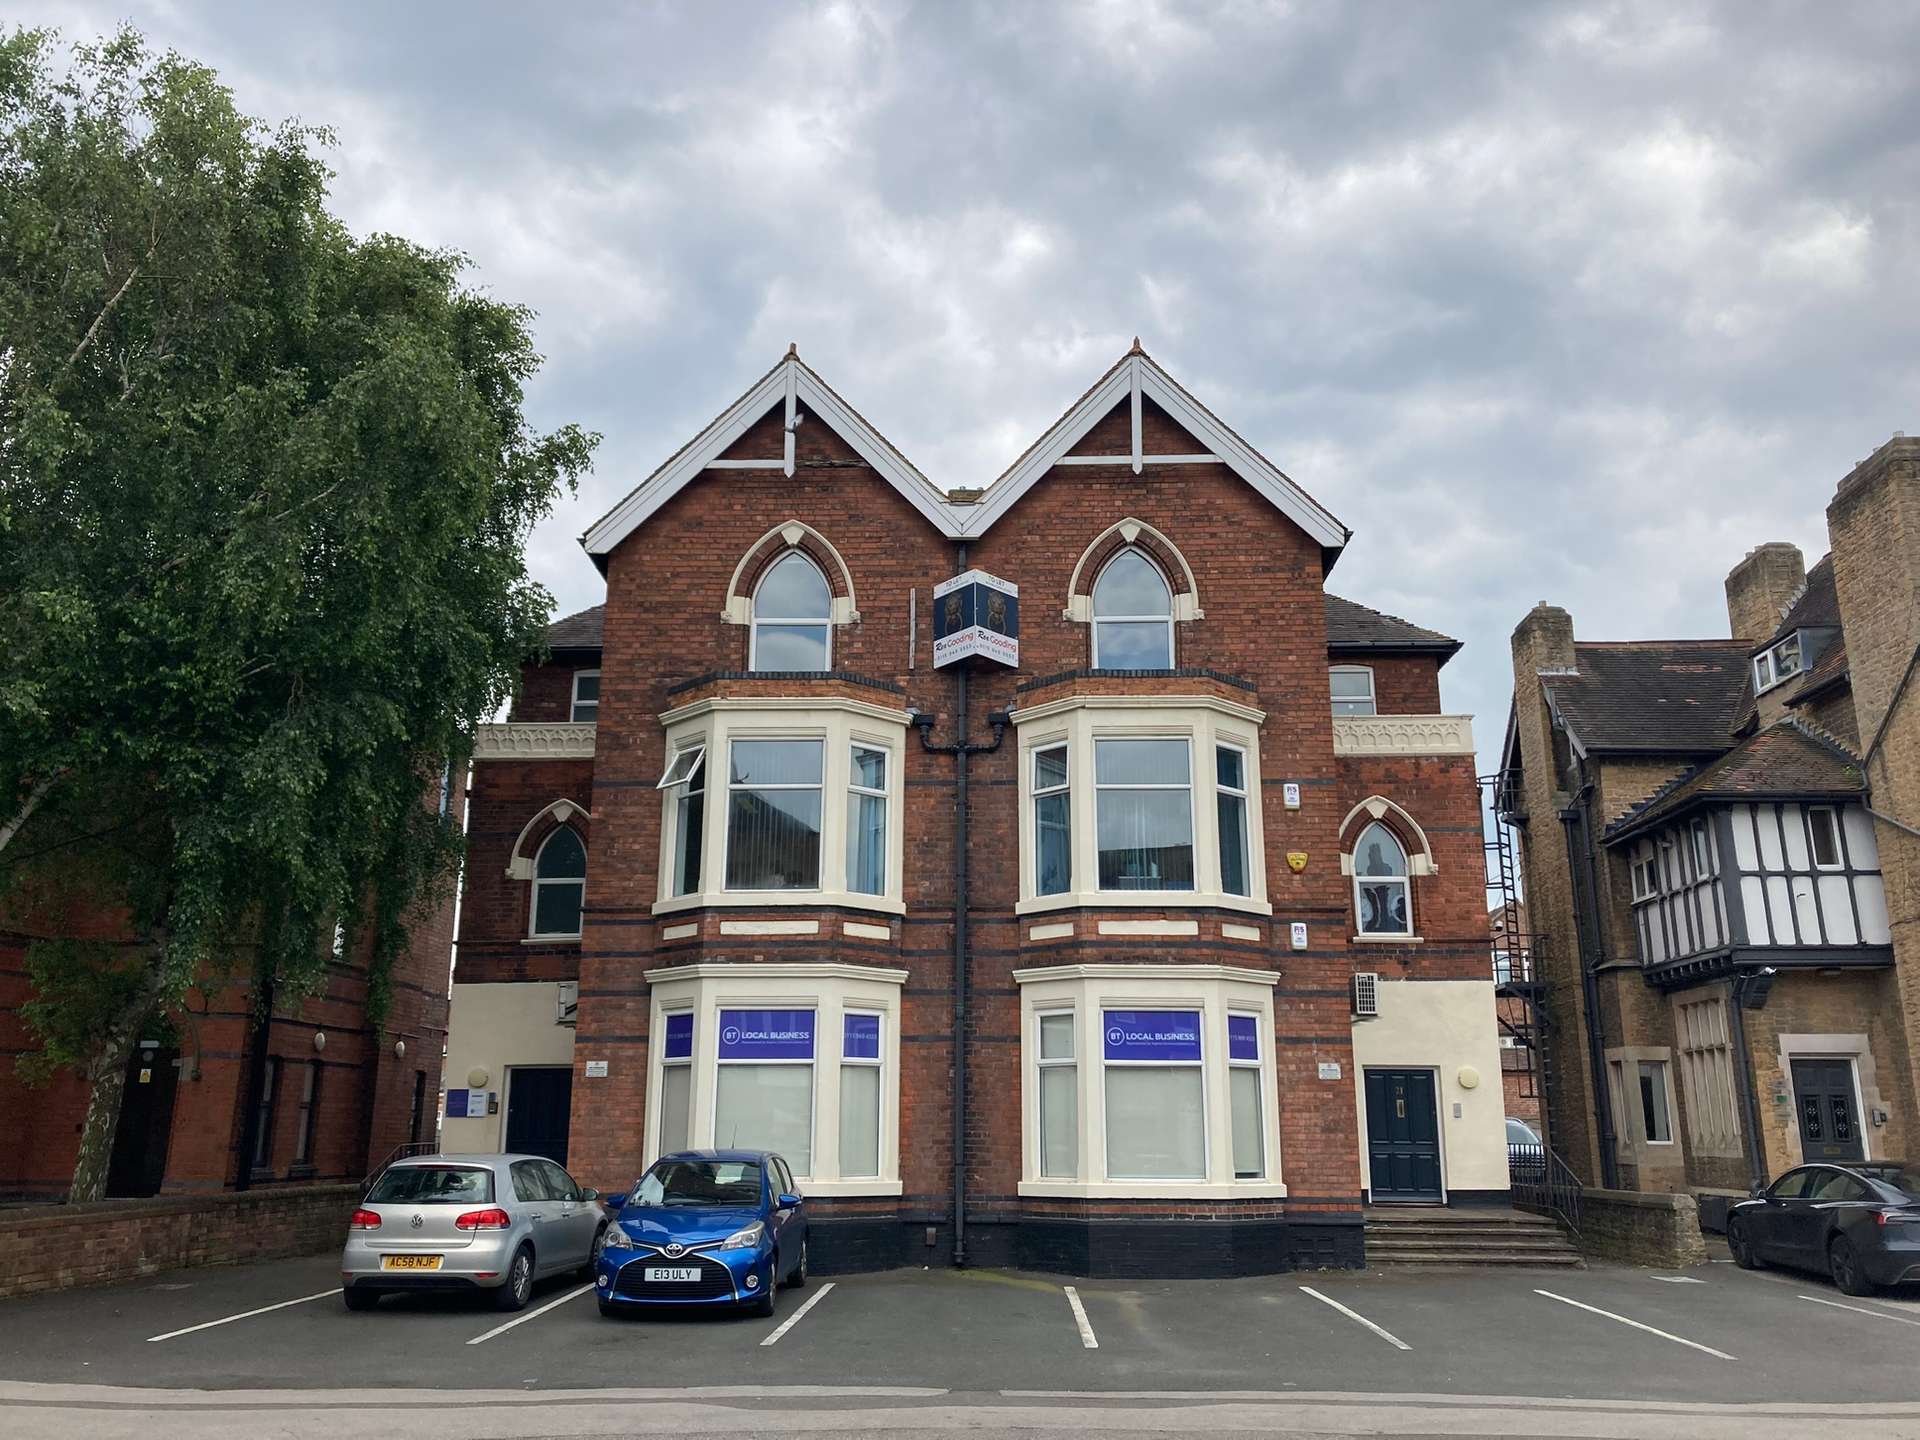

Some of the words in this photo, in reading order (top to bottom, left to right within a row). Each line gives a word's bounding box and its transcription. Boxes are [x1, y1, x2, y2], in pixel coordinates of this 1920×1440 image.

[725, 1031, 737, 1040] BT
[741, 1031, 769, 1040] LOCAL
[770, 1031, 810, 1040] BUSINESS
[1110, 1031, 1121, 1041] BT
[1126, 1032, 1154, 1041] LOCAL
[1155, 1032, 1195, 1041] BUSINESS
[389, 1257, 414, 1267] AC58
[416, 1257, 435, 1267] NJF
[654, 1269, 670, 1280] E13
[672, 1269, 692, 1279] ULY
